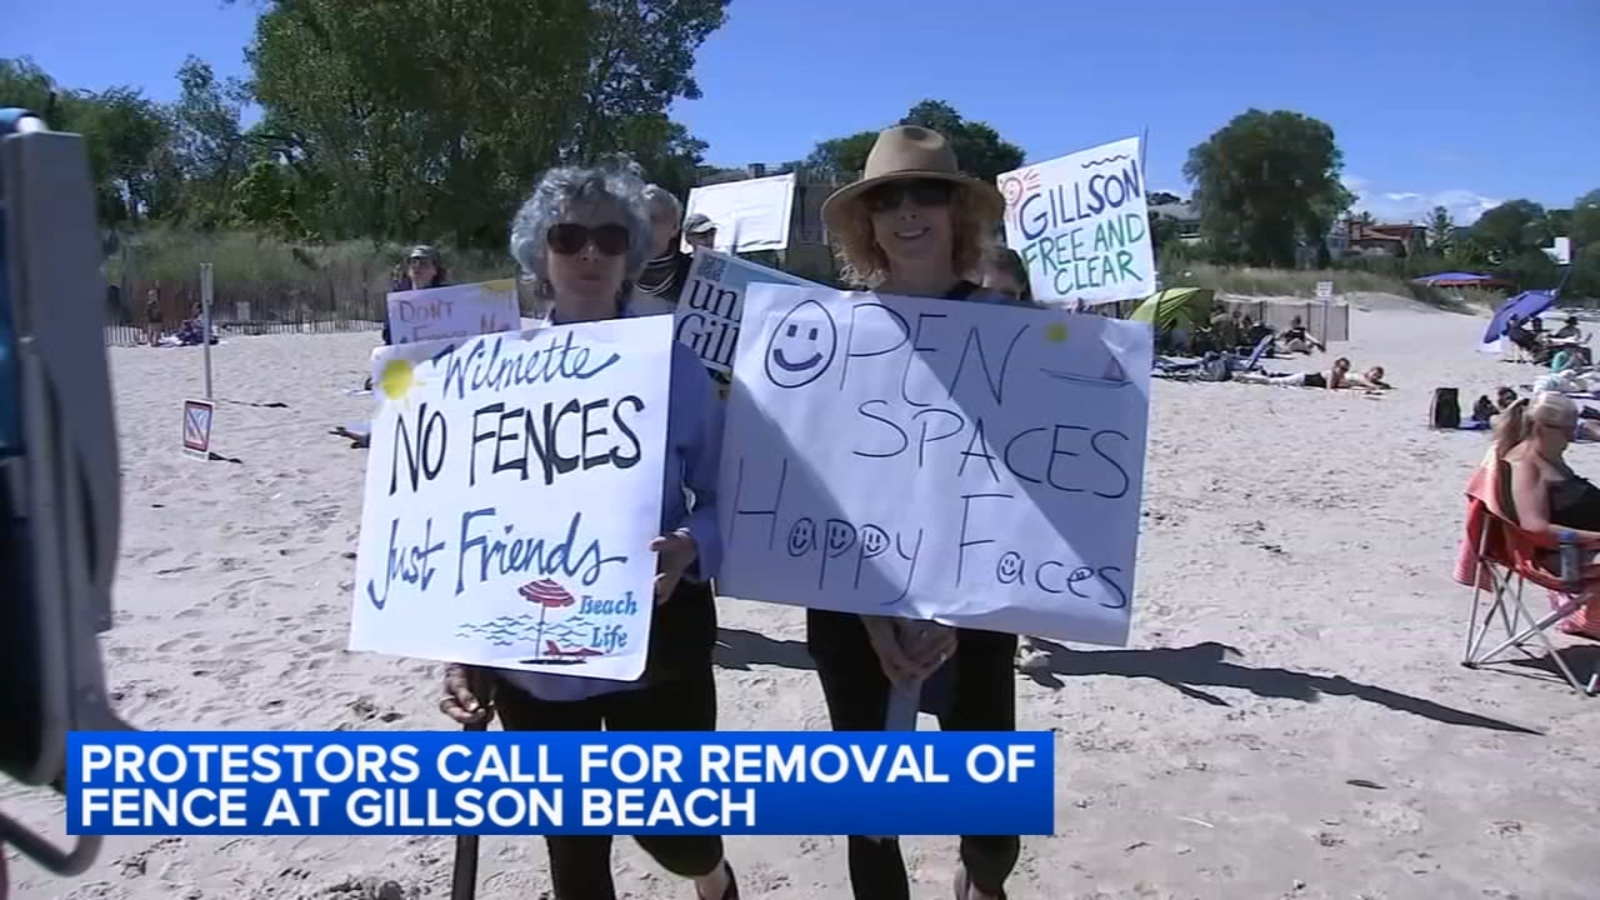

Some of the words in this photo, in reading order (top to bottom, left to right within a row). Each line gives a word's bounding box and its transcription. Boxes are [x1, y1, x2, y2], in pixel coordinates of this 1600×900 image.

[1019, 159, 1140, 240] GILLSON
[1022, 227, 1085, 275] FREE
[1094, 213, 1145, 251] AND
[1054, 250, 1143, 295] CLEAR
[689, 279, 741, 322] un
[432, 331, 620, 399] Wilmette
[764, 299, 1030, 406] OPEN
[389, 402, 447, 496] NO
[469, 395, 645, 487] FENCES
[853, 399, 1130, 499] SPACES
[366, 517, 446, 611] Just
[454, 507, 628, 597] Friends
[728, 457, 923, 606] Happy
[955, 494, 1127, 609] Faces
[578, 591, 637, 617] Beach
[591, 626, 628, 649] Life
